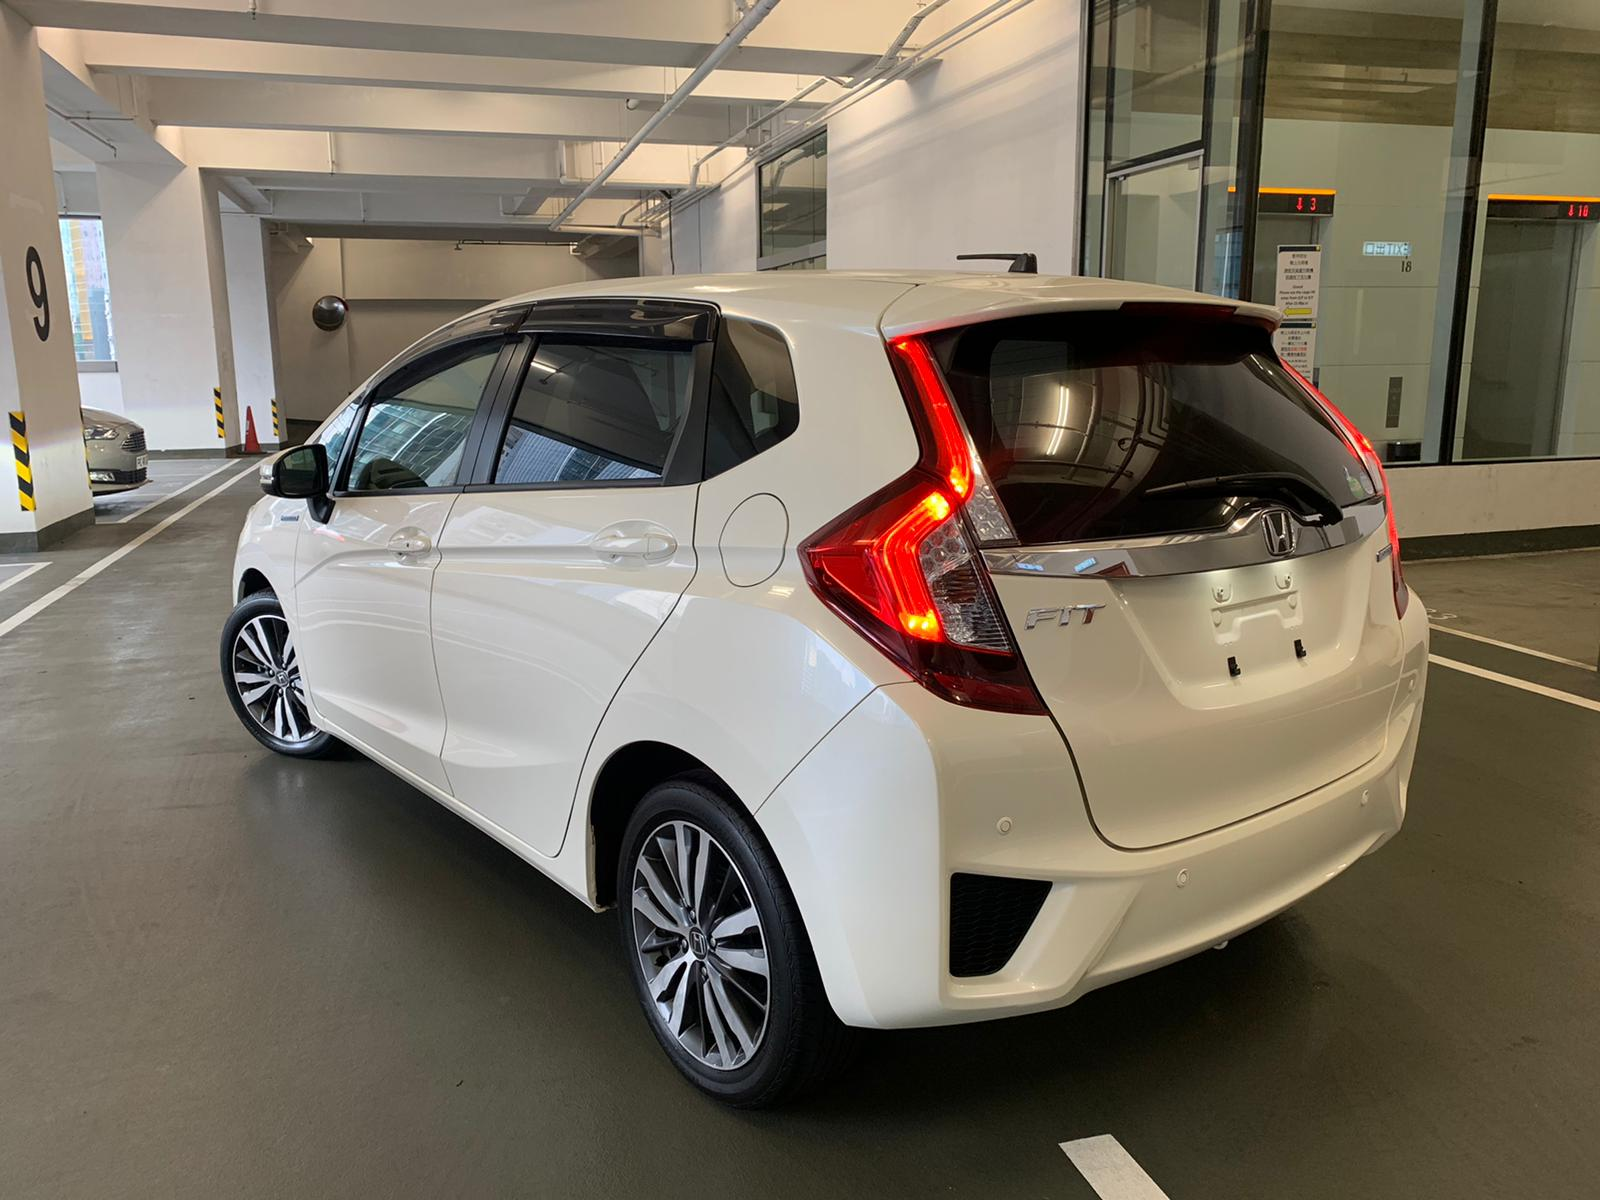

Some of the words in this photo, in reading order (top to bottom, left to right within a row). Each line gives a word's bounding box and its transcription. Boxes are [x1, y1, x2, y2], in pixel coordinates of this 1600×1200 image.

[1310, 197, 1317, 211] 3
[1401, 260, 1412, 273] 18
[25, 245, 50, 342] 9
[1024, 604, 1106, 631] FIT
